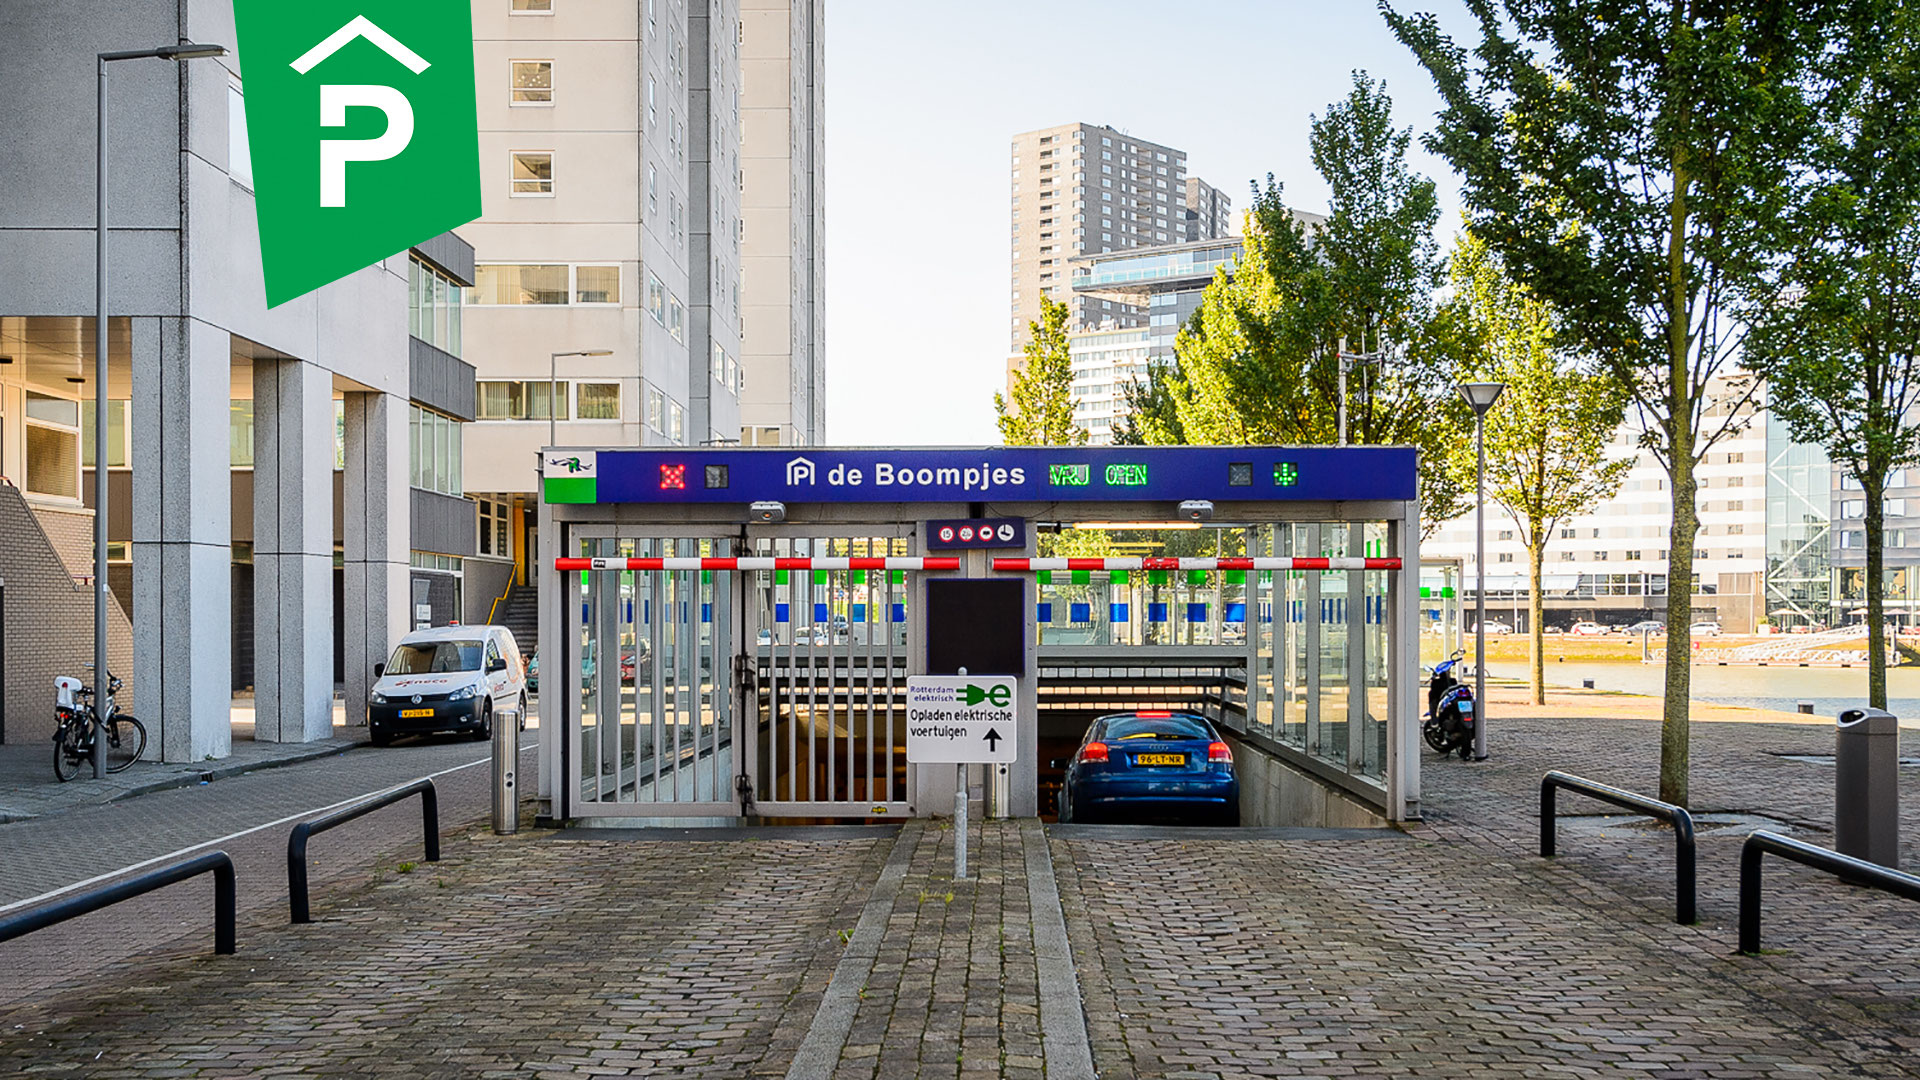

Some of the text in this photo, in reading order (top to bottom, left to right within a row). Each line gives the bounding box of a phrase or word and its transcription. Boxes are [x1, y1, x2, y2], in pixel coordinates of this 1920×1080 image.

[827, 464, 863, 486] de
[875, 463, 1026, 490] Boompjes
[1105, 464, 1147, 486] OPEN
[910, 685, 954, 694] Rotterdam
[914, 694, 954, 702] elektrisch
[910, 709, 1013, 723] Opladen elektrische
[910, 725, 967, 741] voertuigen
[1140, 755, 1182, 764] 96-LT-NR
